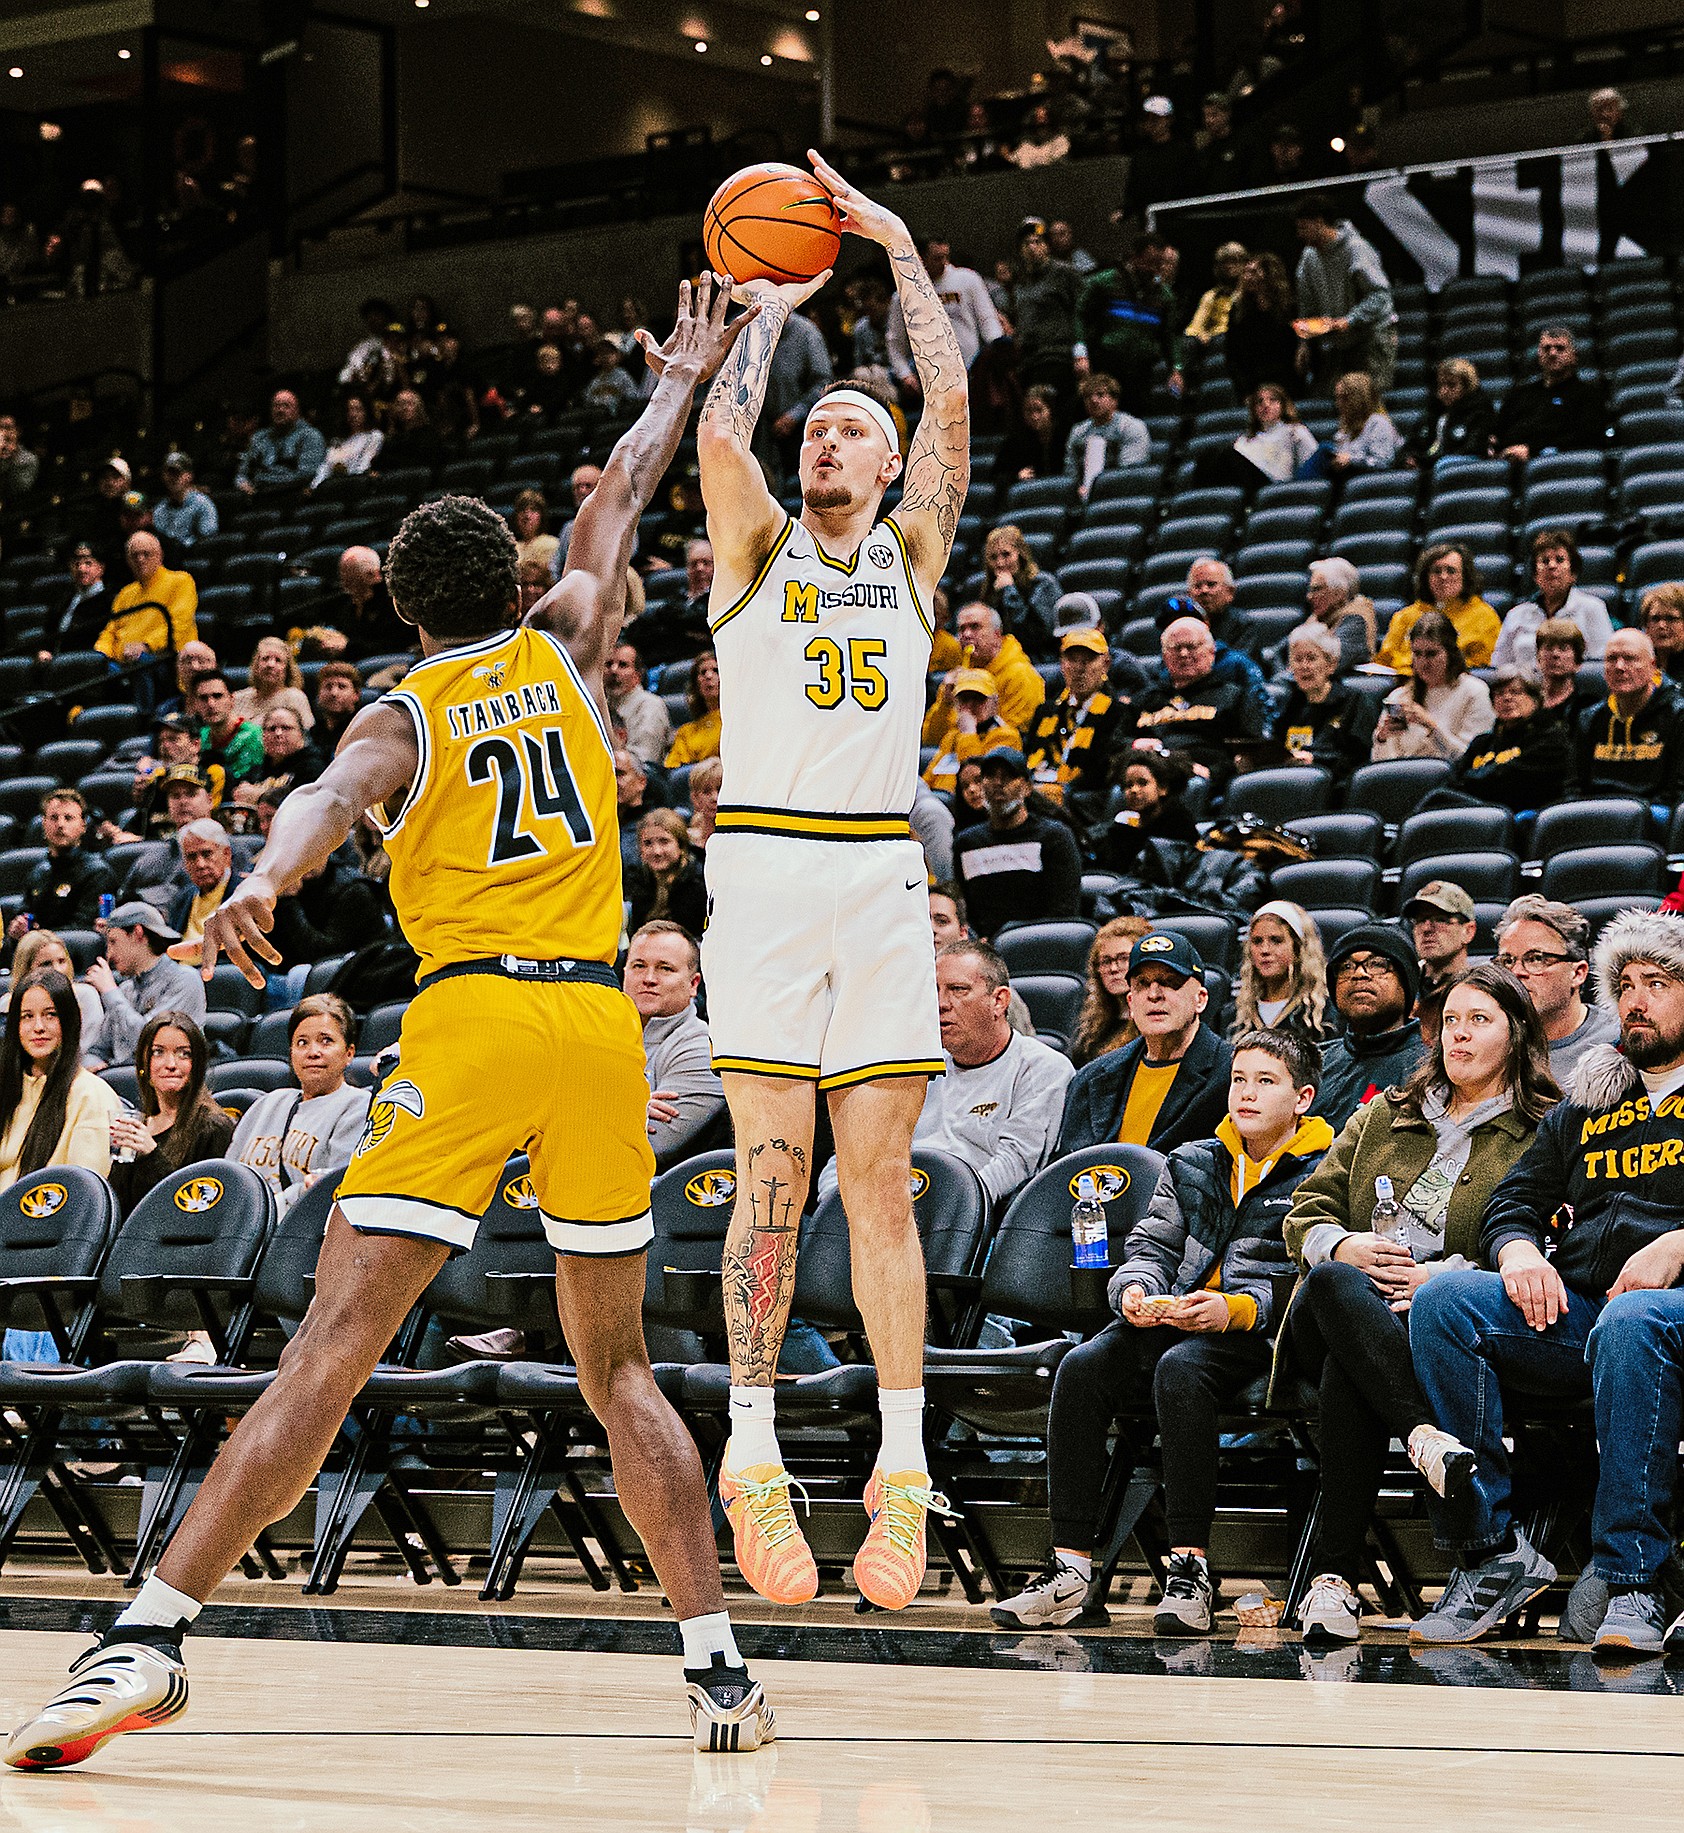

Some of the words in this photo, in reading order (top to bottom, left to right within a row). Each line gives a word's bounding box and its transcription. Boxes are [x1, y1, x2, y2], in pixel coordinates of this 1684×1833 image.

[868, 546, 894, 568] SEC
[780, 580, 898, 623] MISSOURI
[804, 637, 889, 712] 35
[446, 681, 562, 740] STANBACK
[465, 728, 596, 868] 24
[1583, 1138, 1684, 1179] TIGER
